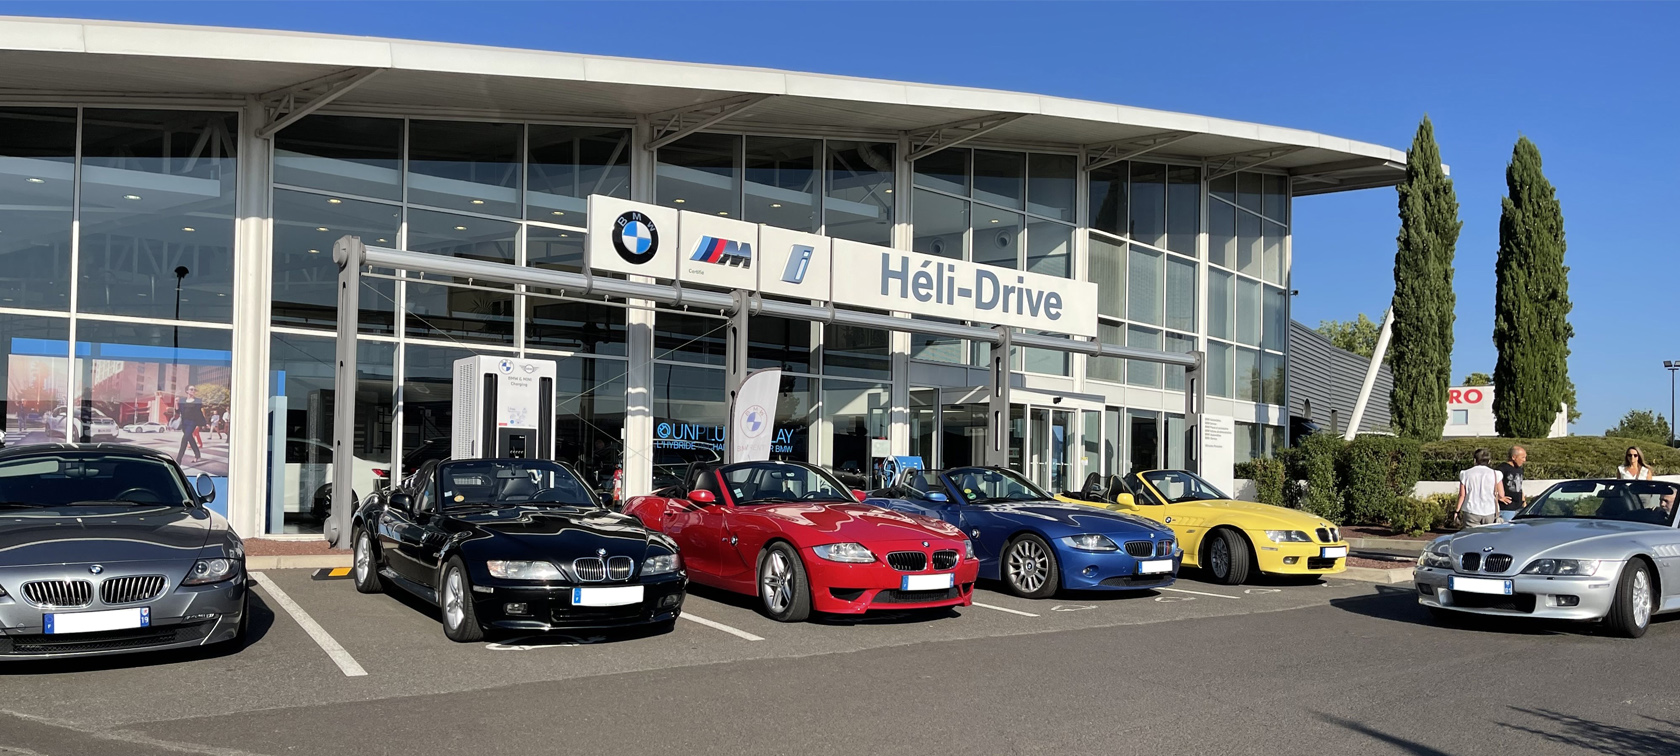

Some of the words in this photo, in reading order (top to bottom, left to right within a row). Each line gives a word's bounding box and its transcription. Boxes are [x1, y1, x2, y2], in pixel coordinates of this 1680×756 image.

[617, 212, 656, 232] BMW
[880, 252, 1063, 321] Héli-Drive
[672, 423, 725, 441] UNPLU
[775, 445, 794, 453] BMW
[141, 616, 149, 624] 19
